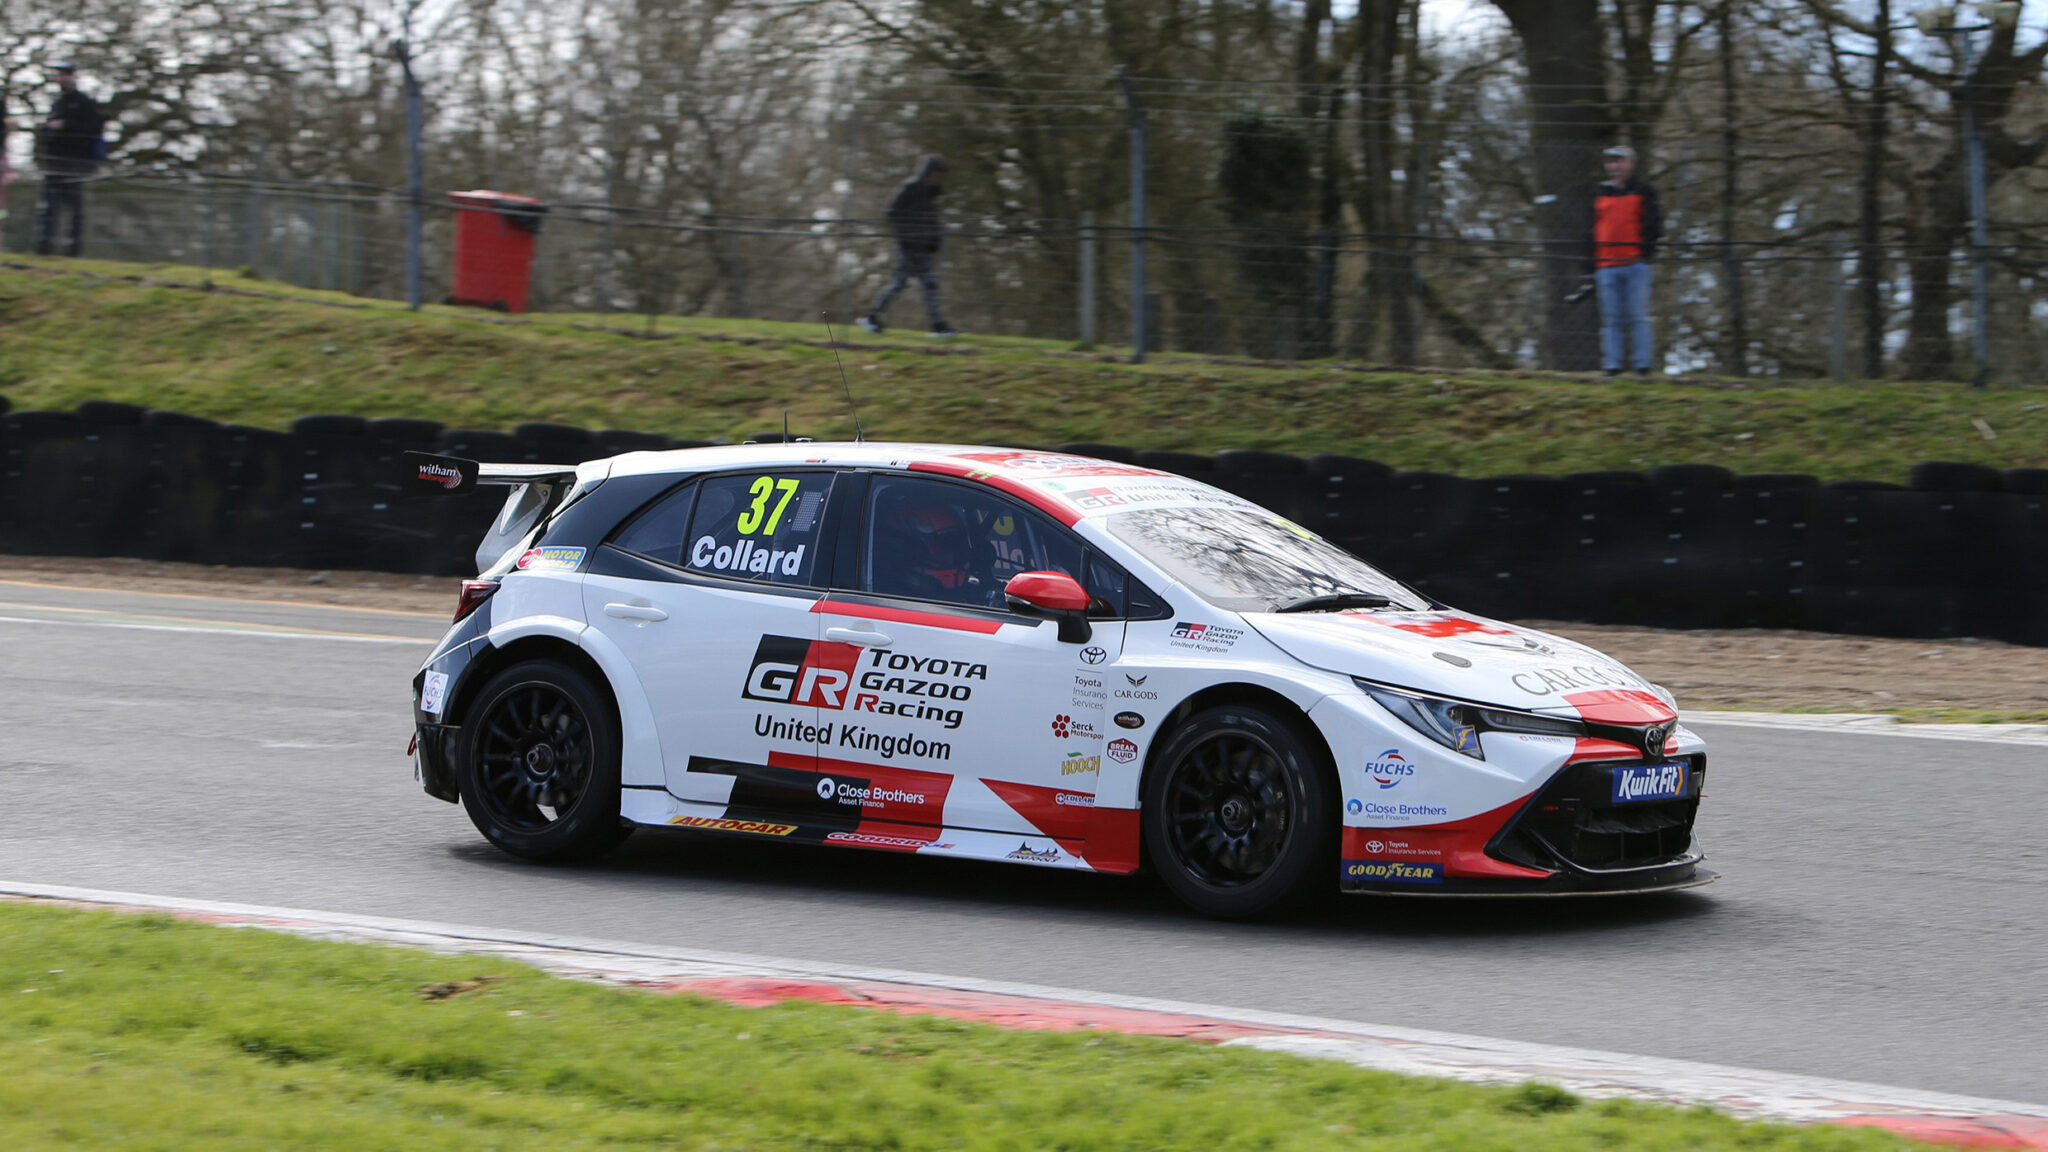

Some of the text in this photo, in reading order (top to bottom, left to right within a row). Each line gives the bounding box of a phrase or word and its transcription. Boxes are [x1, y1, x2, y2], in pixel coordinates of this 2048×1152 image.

[419, 464, 456, 477] witham
[737, 476, 800, 536] 37
[543, 550, 581, 560] MOTOR
[692, 535, 805, 576] Collard
[1172, 628, 1203, 640] GR
[1205, 631, 1238, 640] GAZOO
[1209, 625, 1244, 635] TOYOTA
[1170, 640, 1228, 653] United Kingdom
[1203, 636, 1235, 646] Racing
[869, 648, 988, 680] TOYOTA
[747, 661, 849, 707] GR
[859, 672, 972, 701] GAZOO
[1075, 676, 1102, 688] Toyota
[1512, 668, 1578, 696] CAR
[1072, 687, 1108, 700] Insuranc
[1114, 690, 1158, 700] CAR GODS
[1072, 698, 1104, 710] Services
[853, 693, 964, 729] Racing
[1071, 721, 1094, 732] Serck
[754, 713, 951, 760] United Kingdom
[1110, 743, 1135, 752] BREAK
[1111, 750, 1133, 759] FLUID
[1061, 755, 1101, 777] HOOCH
[1365, 762, 1415, 776] FUCHS
[837, 784, 925, 804] Close Brothers
[838, 797, 885, 808] Asset Finance
[1365, 802, 1447, 816] Close Brothers
[675, 816, 790, 836] AUTOCAR
[1417, 848, 1441, 856] Services
